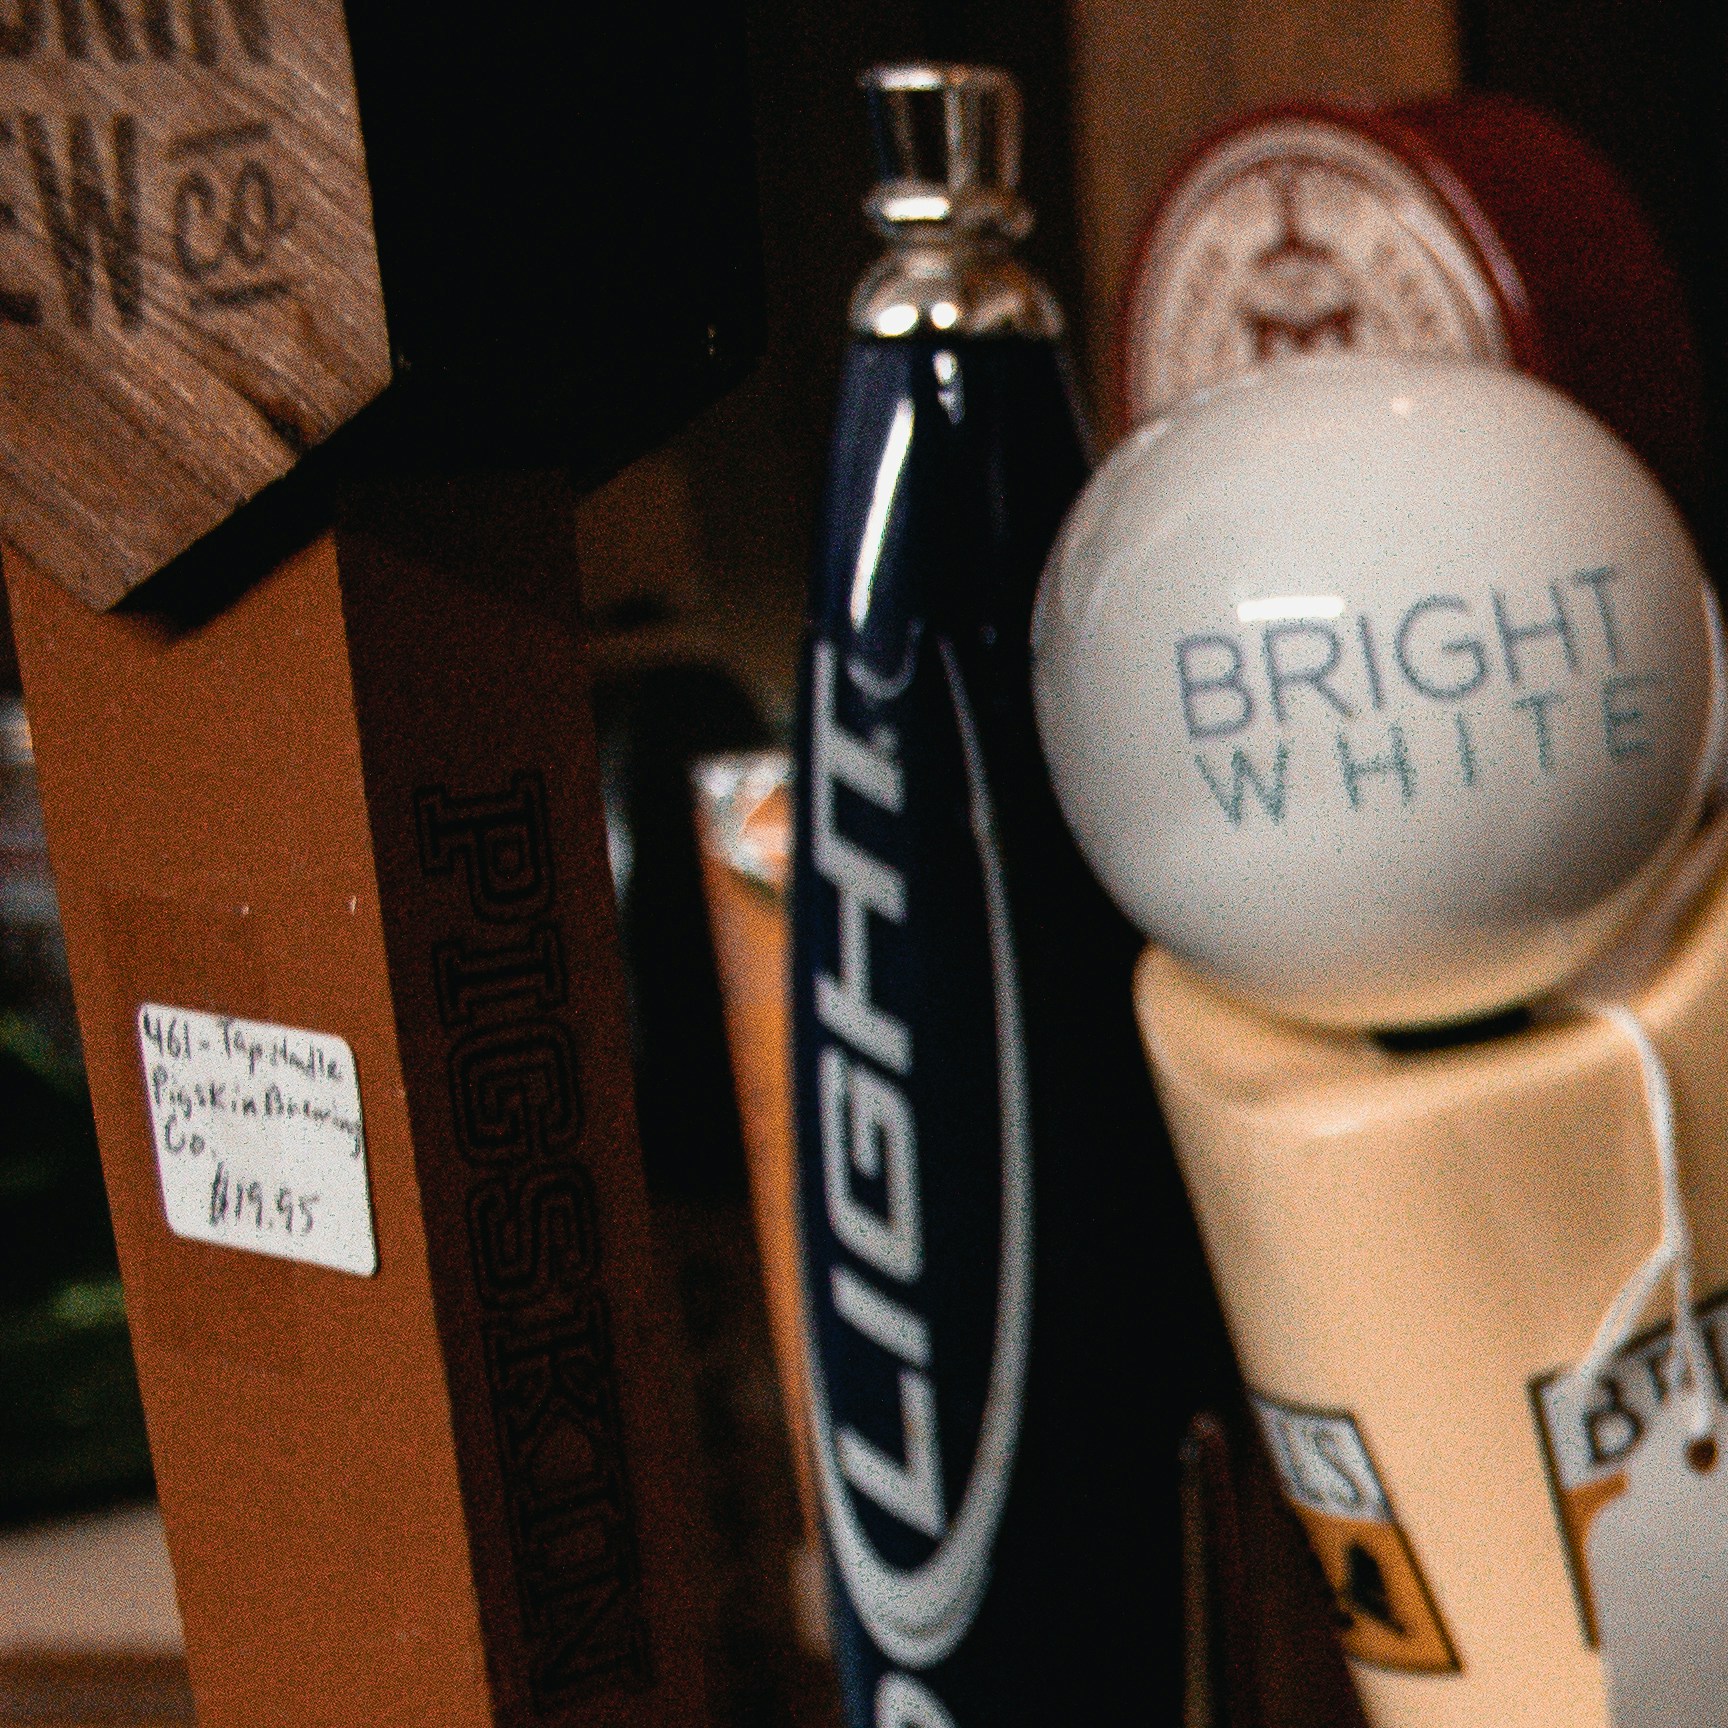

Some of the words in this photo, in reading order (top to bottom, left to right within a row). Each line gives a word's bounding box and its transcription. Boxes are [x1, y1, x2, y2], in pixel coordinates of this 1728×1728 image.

[1175, 565, 1619, 743] BRIGHT
[1194, 672, 1656, 829] WHITE
[413, 766, 659, 1717] PIGSKIN
[813, 640, 943, 1538] LIGHT
